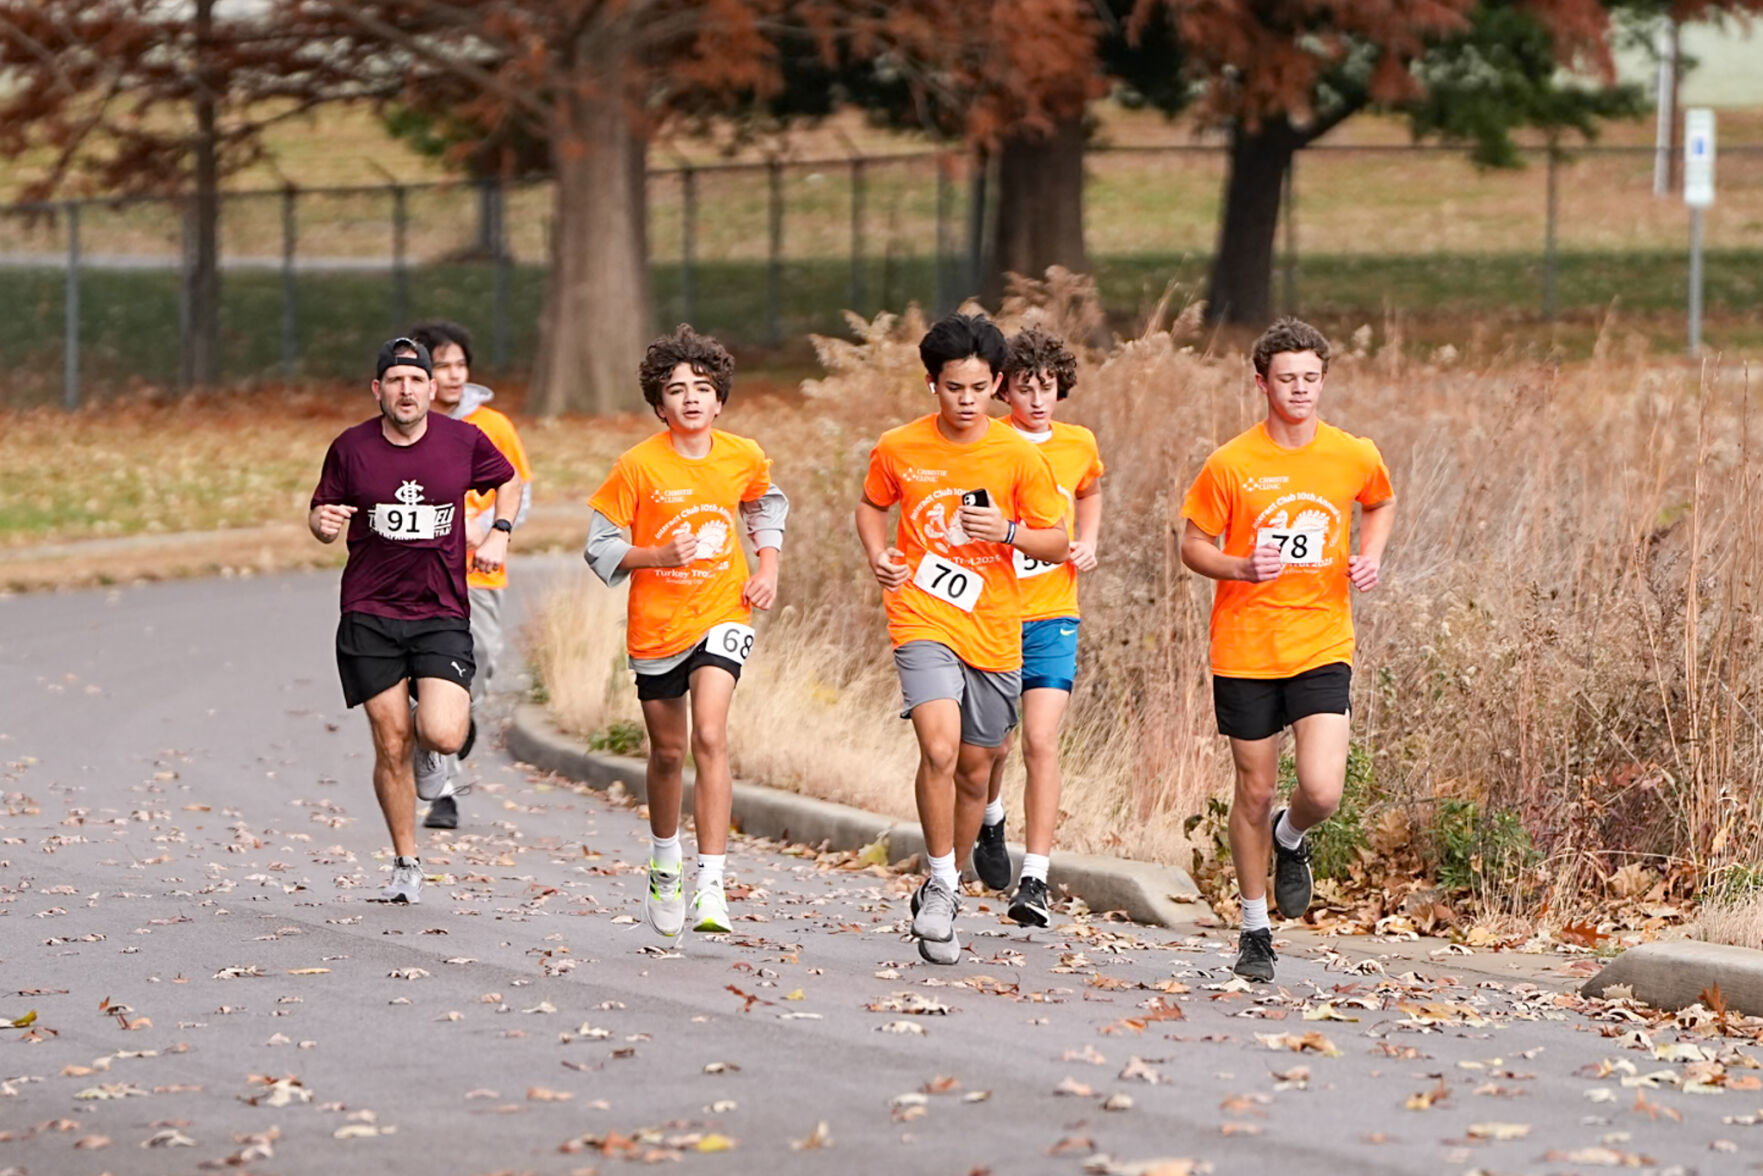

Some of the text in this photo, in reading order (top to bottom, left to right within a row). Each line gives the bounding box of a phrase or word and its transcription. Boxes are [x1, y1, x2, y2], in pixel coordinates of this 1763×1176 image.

[932, 487, 953, 499] Club
[1276, 492, 1297, 506] Club
[680, 503, 700, 518] Club
[700, 503, 718, 513] 10th
[387, 510, 420, 533] 91
[1272, 534, 1308, 559] 78
[1023, 554, 1052, 571] 5
[654, 568, 689, 579] Turkey
[691, 568, 711, 578] Tro
[930, 563, 968, 599] 70
[722, 628, 755, 660] 68
